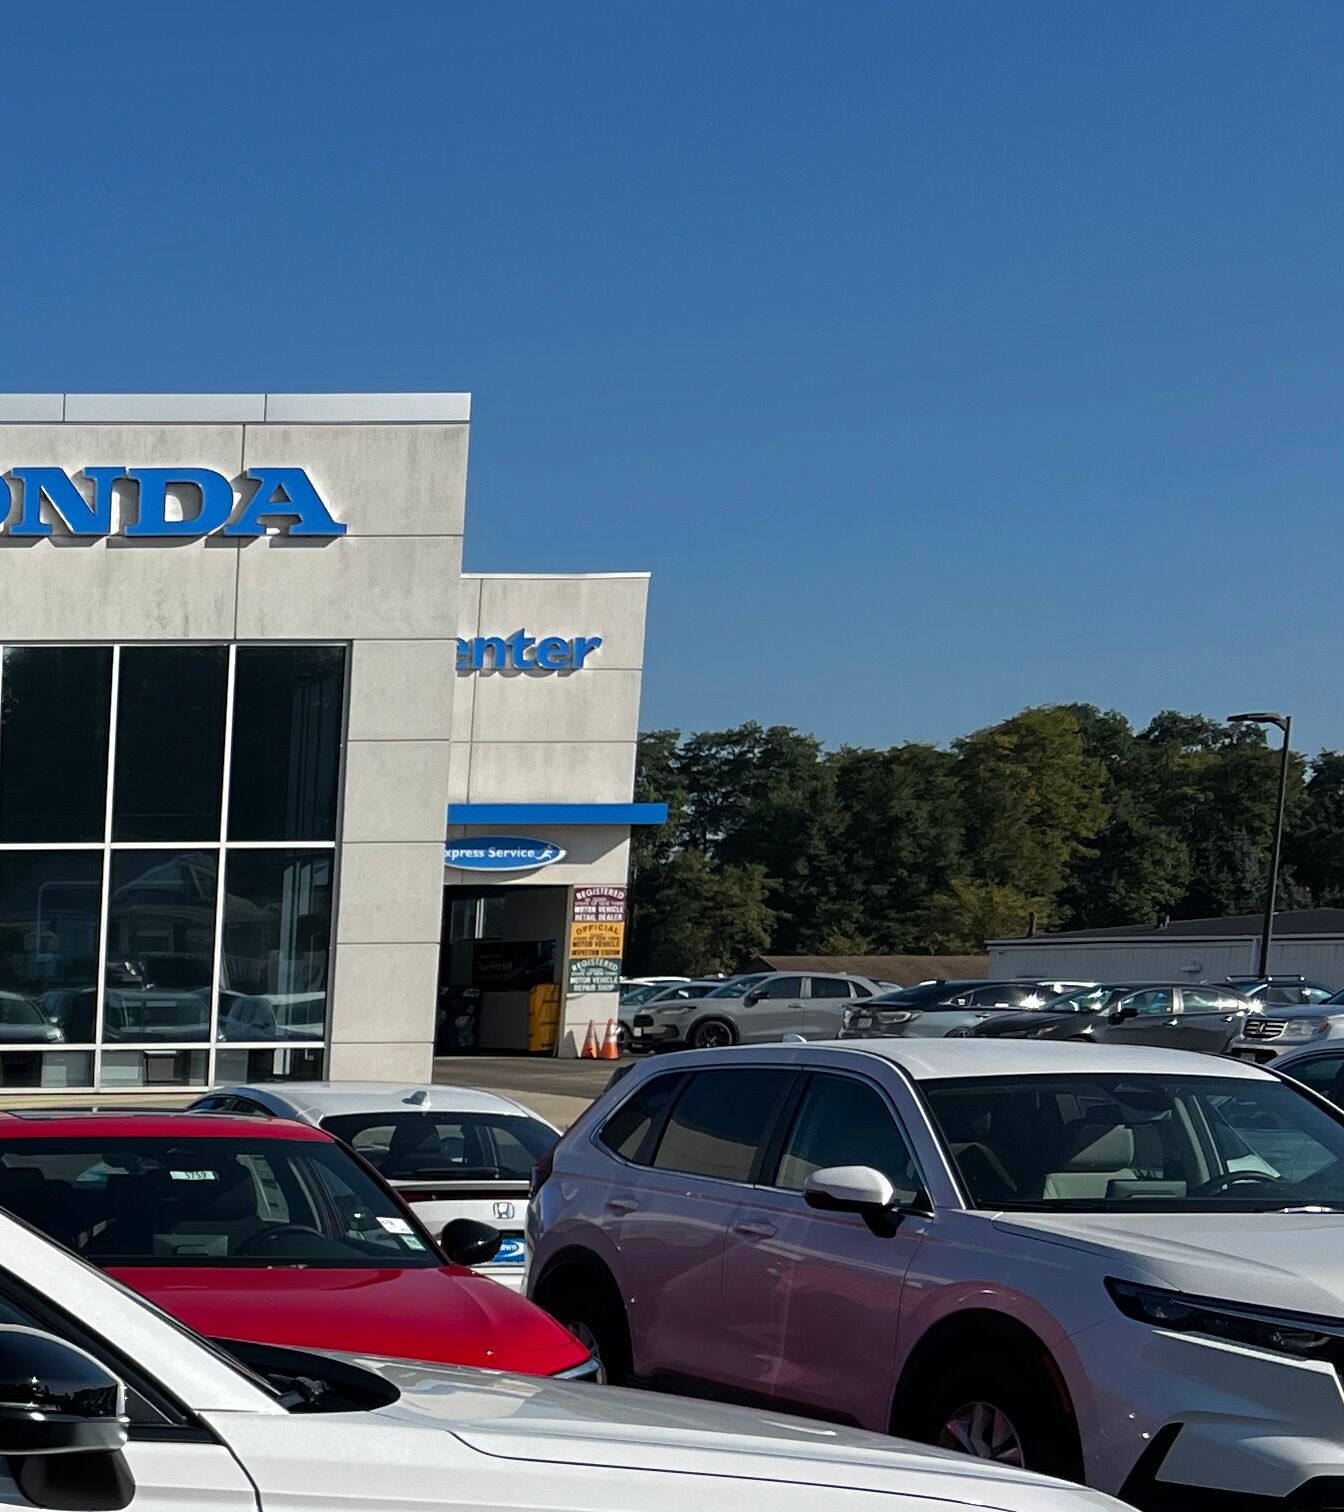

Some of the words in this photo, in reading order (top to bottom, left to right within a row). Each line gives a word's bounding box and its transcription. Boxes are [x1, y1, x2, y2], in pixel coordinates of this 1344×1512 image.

[488, 846, 536, 858] Service
[575, 887, 625, 900] REGISTERED
[574, 906, 596, 914] MOTOR
[598, 906, 624, 914] VEHICLE
[575, 924, 619, 935] OFFICIAL
[571, 959, 619, 971] REGISTERED
[592, 976, 619, 984] VEHICLE
